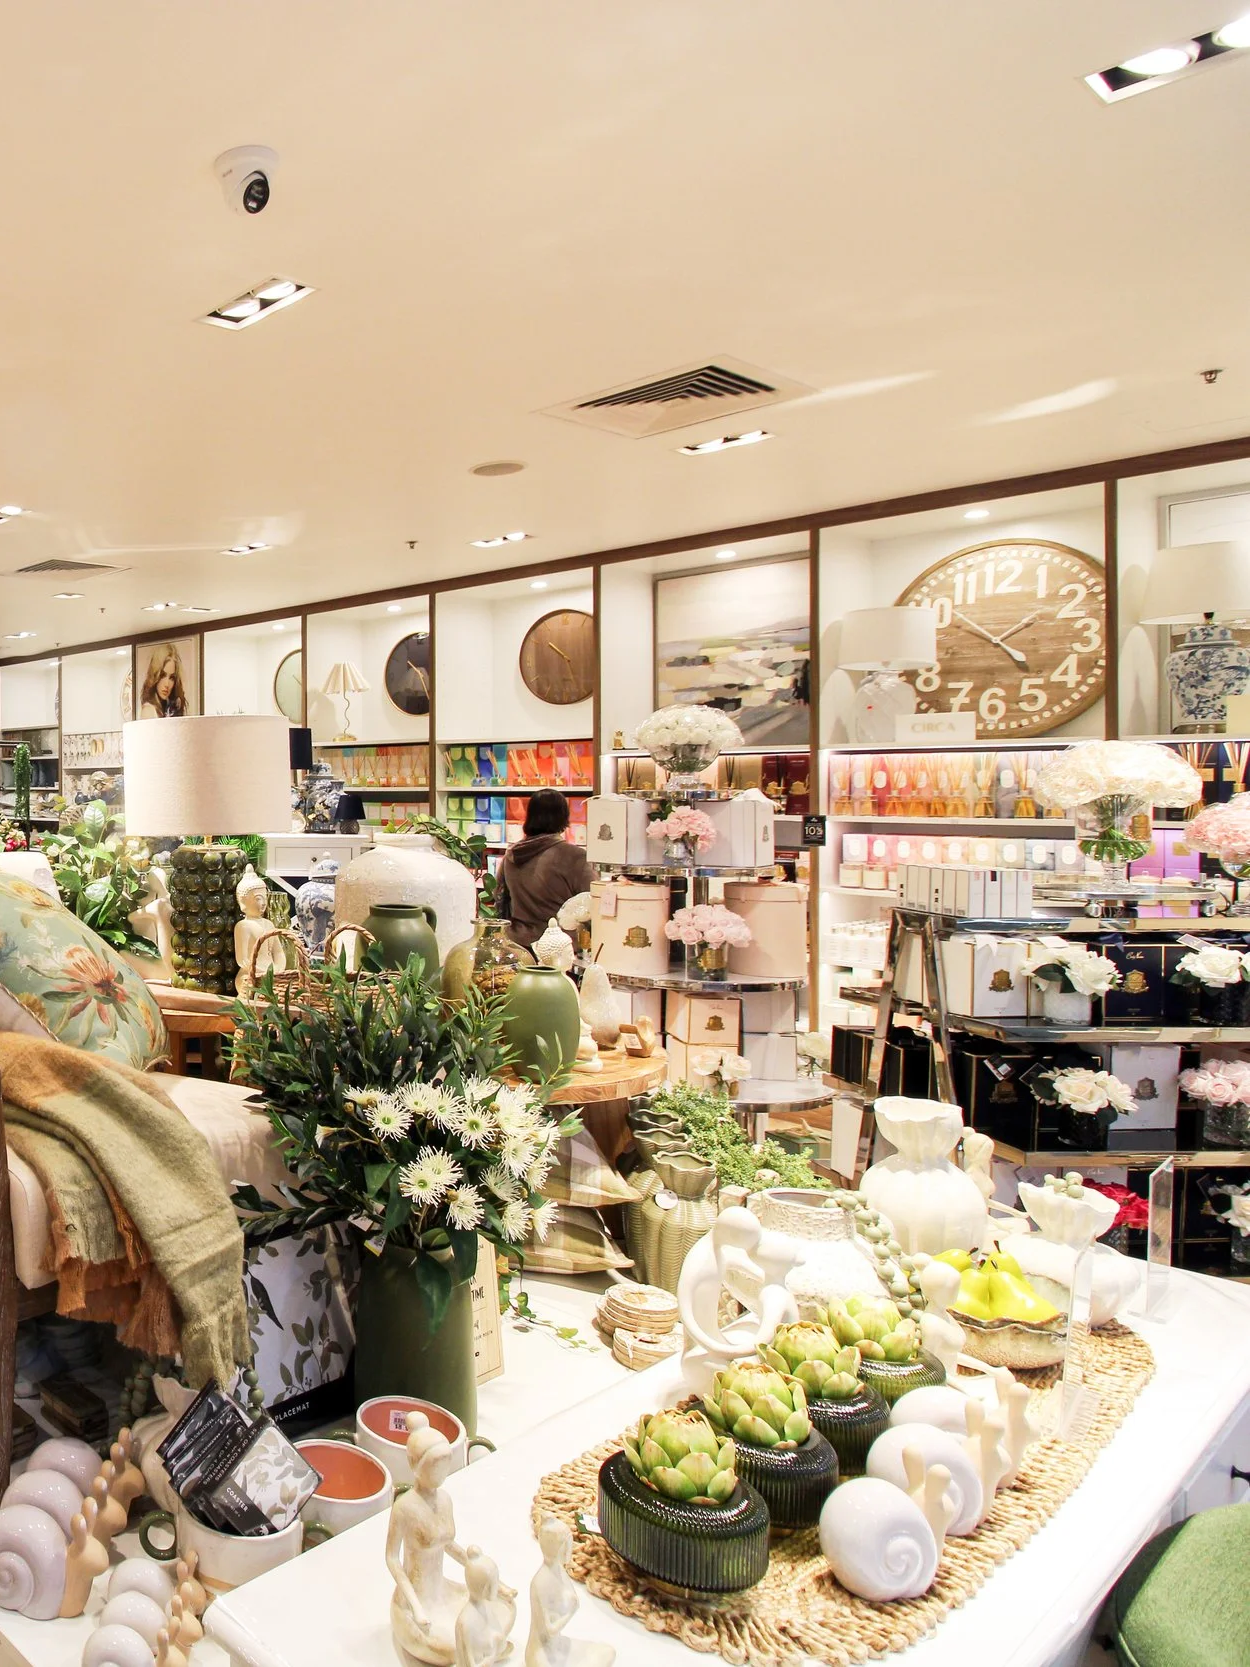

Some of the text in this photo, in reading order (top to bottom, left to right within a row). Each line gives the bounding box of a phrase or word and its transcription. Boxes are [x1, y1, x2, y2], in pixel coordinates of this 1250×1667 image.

[953, 571, 978, 606] 11
[983, 559, 1023, 595] 12
[1036, 564, 1048, 598] 1
[920, 597, 953, 629] 0
[1056, 583, 1087, 619] 2
[1072, 617, 1102, 653] 3
[915, 661, 942, 692] 8
[1050, 653, 1082, 688] 4
[947, 681, 974, 713] 7
[978, 687, 1007, 722] 6
[1018, 677, 1048, 712] 5
[911, 722, 956, 733] CIRCA
[805, 826, 823, 835] 10%
[274, 1401, 310, 1421] PLACEMAT
[240, 1438, 249, 1448] OF
[248, 1427, 257, 1439] SET
[214, 1452, 239, 1481] COASTERS
[226, 1487, 248, 1511] COASTER
